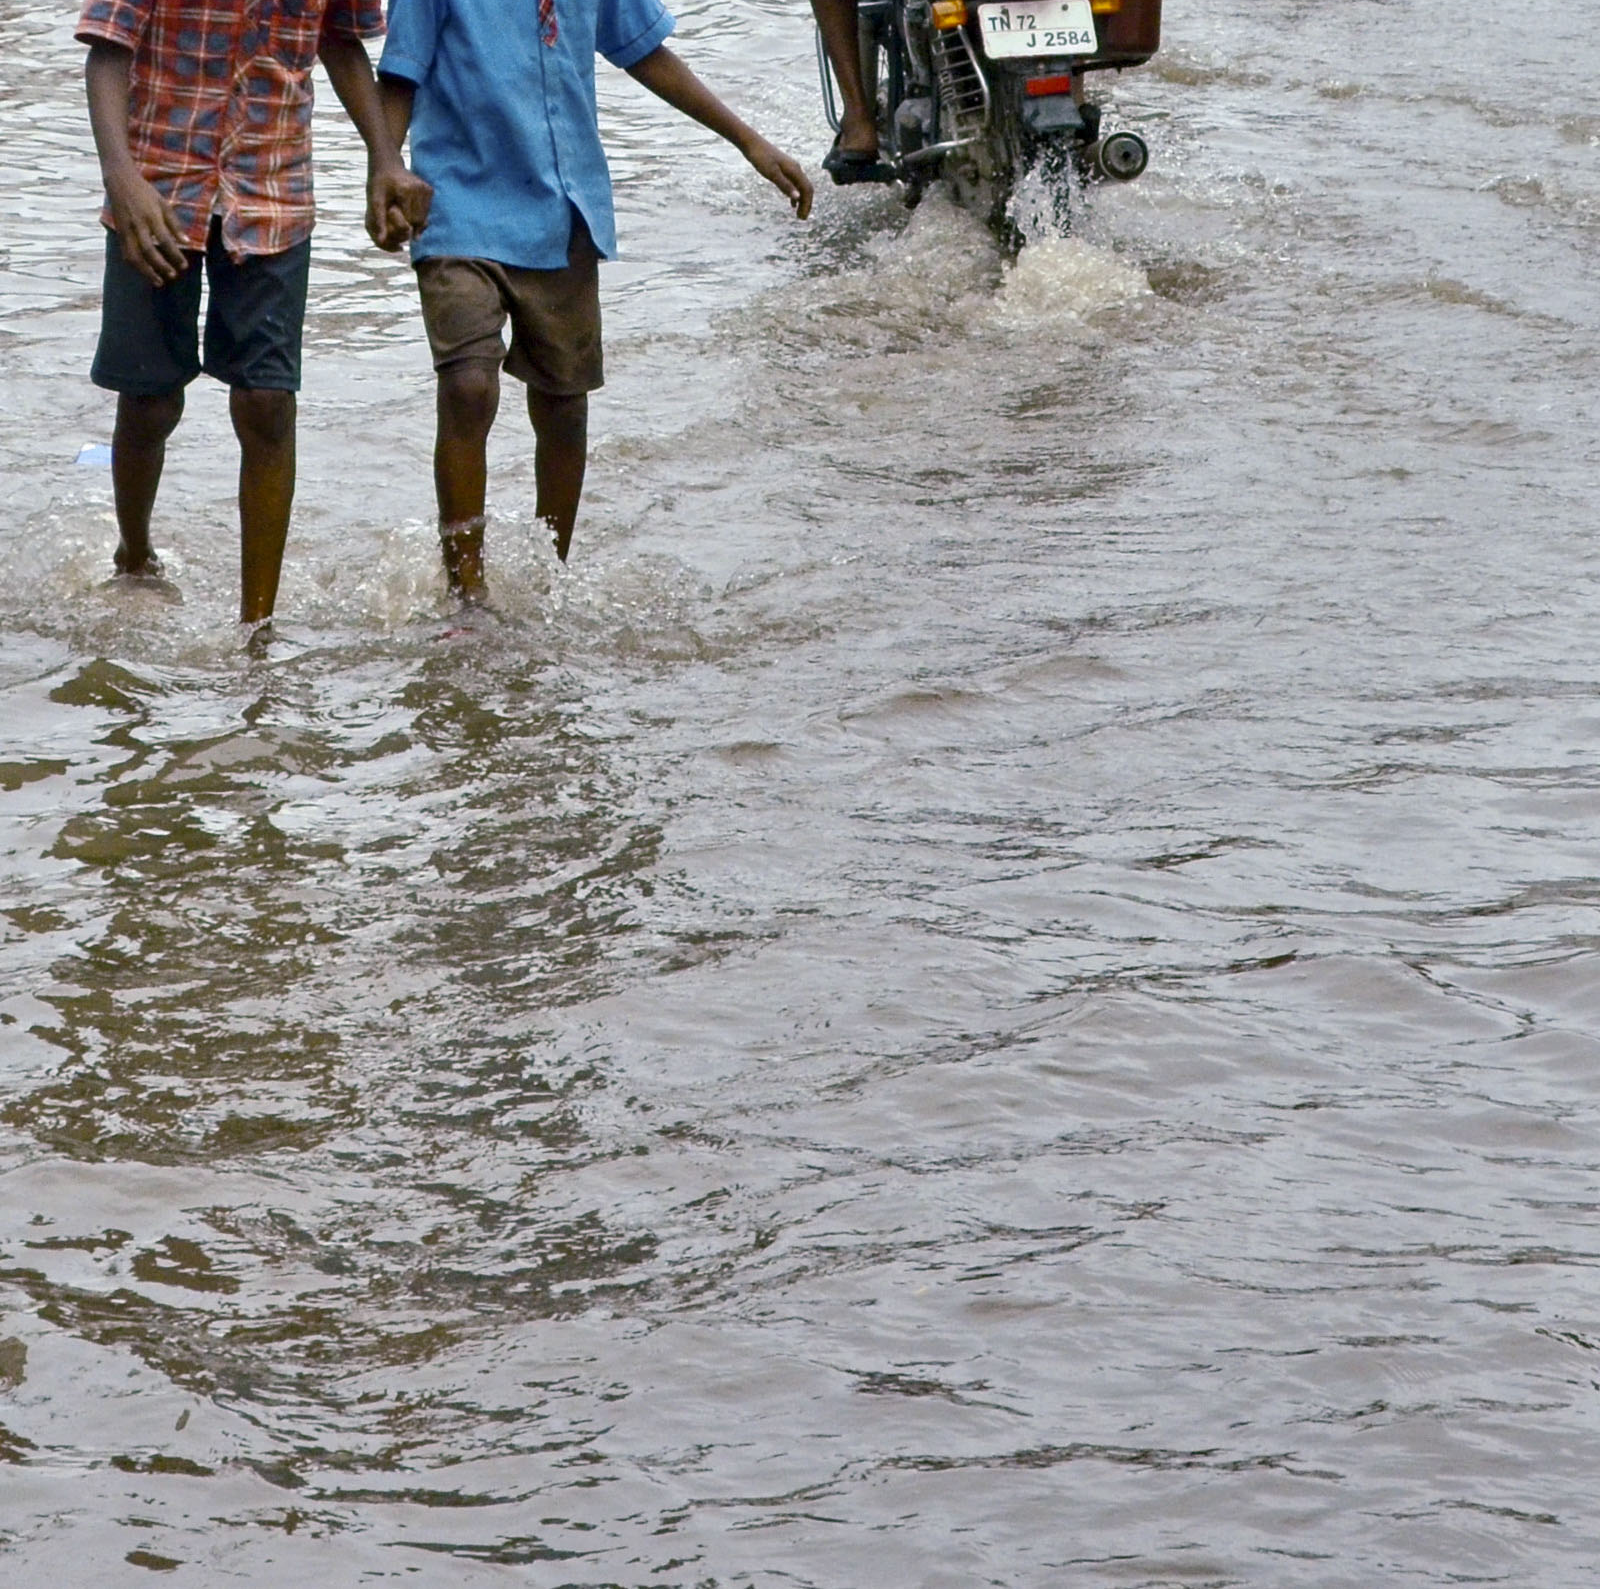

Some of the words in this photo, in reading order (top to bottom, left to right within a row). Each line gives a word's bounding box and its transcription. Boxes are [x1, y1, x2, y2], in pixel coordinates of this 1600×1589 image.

[988, 16, 1012, 32] TN
[1017, 15, 1037, 30] 72
[1026, 33, 1037, 48] J
[1045, 30, 1092, 48] 2584
